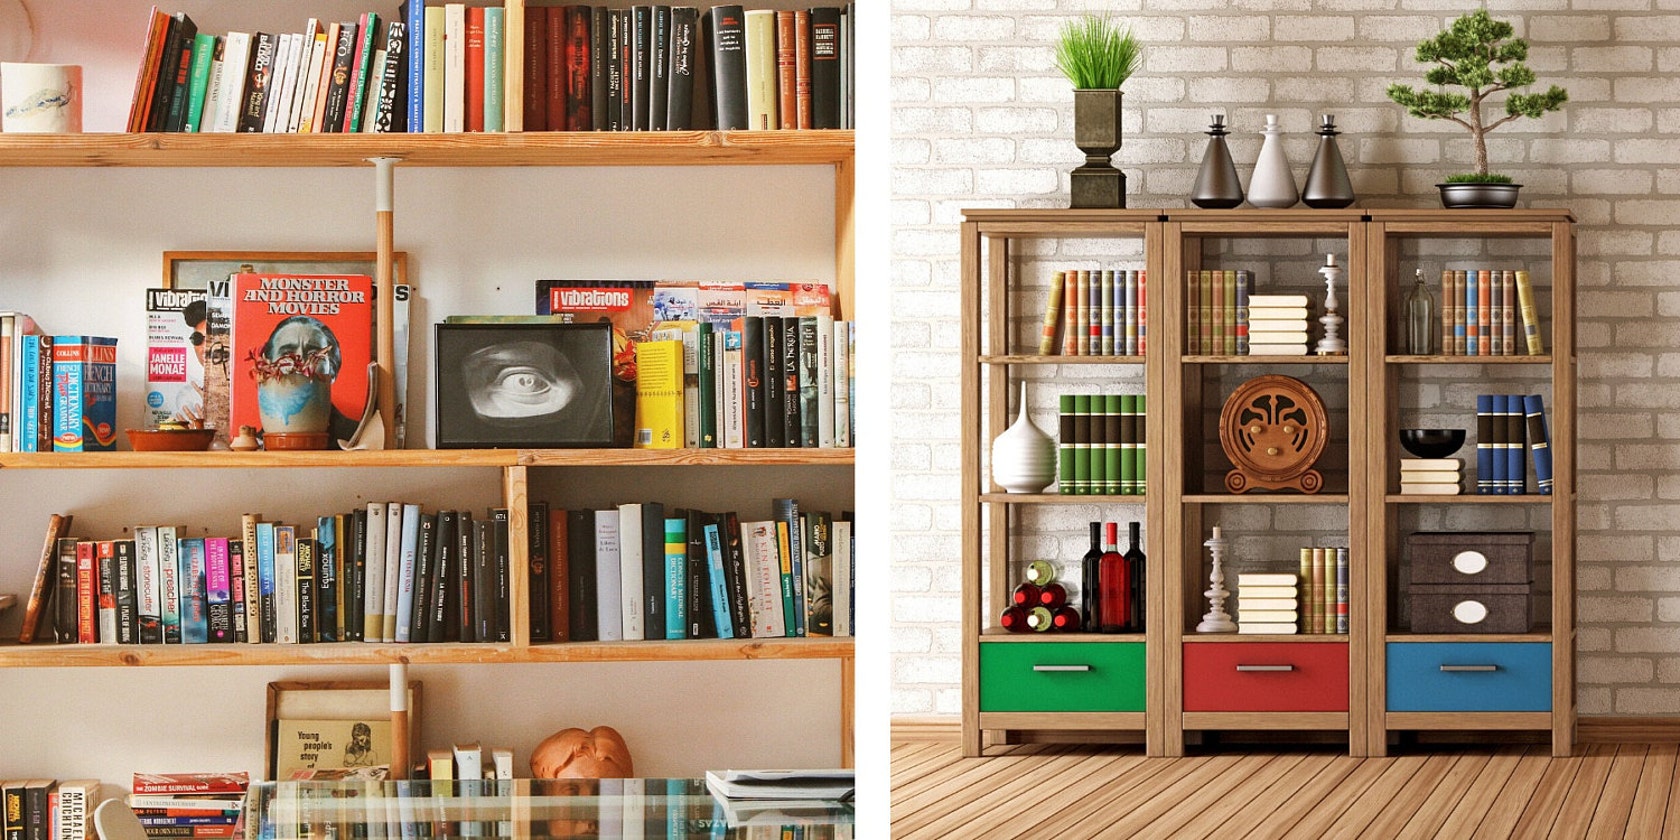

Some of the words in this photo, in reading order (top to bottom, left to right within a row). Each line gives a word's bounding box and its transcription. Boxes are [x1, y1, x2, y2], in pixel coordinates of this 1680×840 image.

[337, 30, 350, 57] ECO
[260, 278, 350, 291] MONSTER
[244, 290, 285, 303] AND
[285, 291, 365, 304] HORROR
[268, 303, 340, 316] MOVIES
[150, 353, 185, 364] JANELLE
[786, 361, 795, 372] LA
[68, 372, 80, 431] DICTIONARY
[60, 396, 68, 431] GRAMMAR
[760, 542, 768, 561] KEN
[190, 547, 202, 588] ELIZABETH
[320, 553, 330, 589] Equinox
[143, 565, 153, 612] stonecutter
[164, 569, 177, 614] preacher
[302, 581, 310, 594] The
[762, 567, 772, 611] FOLLETT
[302, 595, 310, 613] Black
[210, 604, 220, 630] GEORGE
[302, 614, 310, 627] Box
[297, 731, 320, 742] Young
[303, 741, 332, 752] people's
[300, 753, 319, 762] story
[143, 784, 168, 792] ZOMBIE
[62, 793, 73, 840] CRICHTON
[73, 793, 83, 840] MICHAEL
